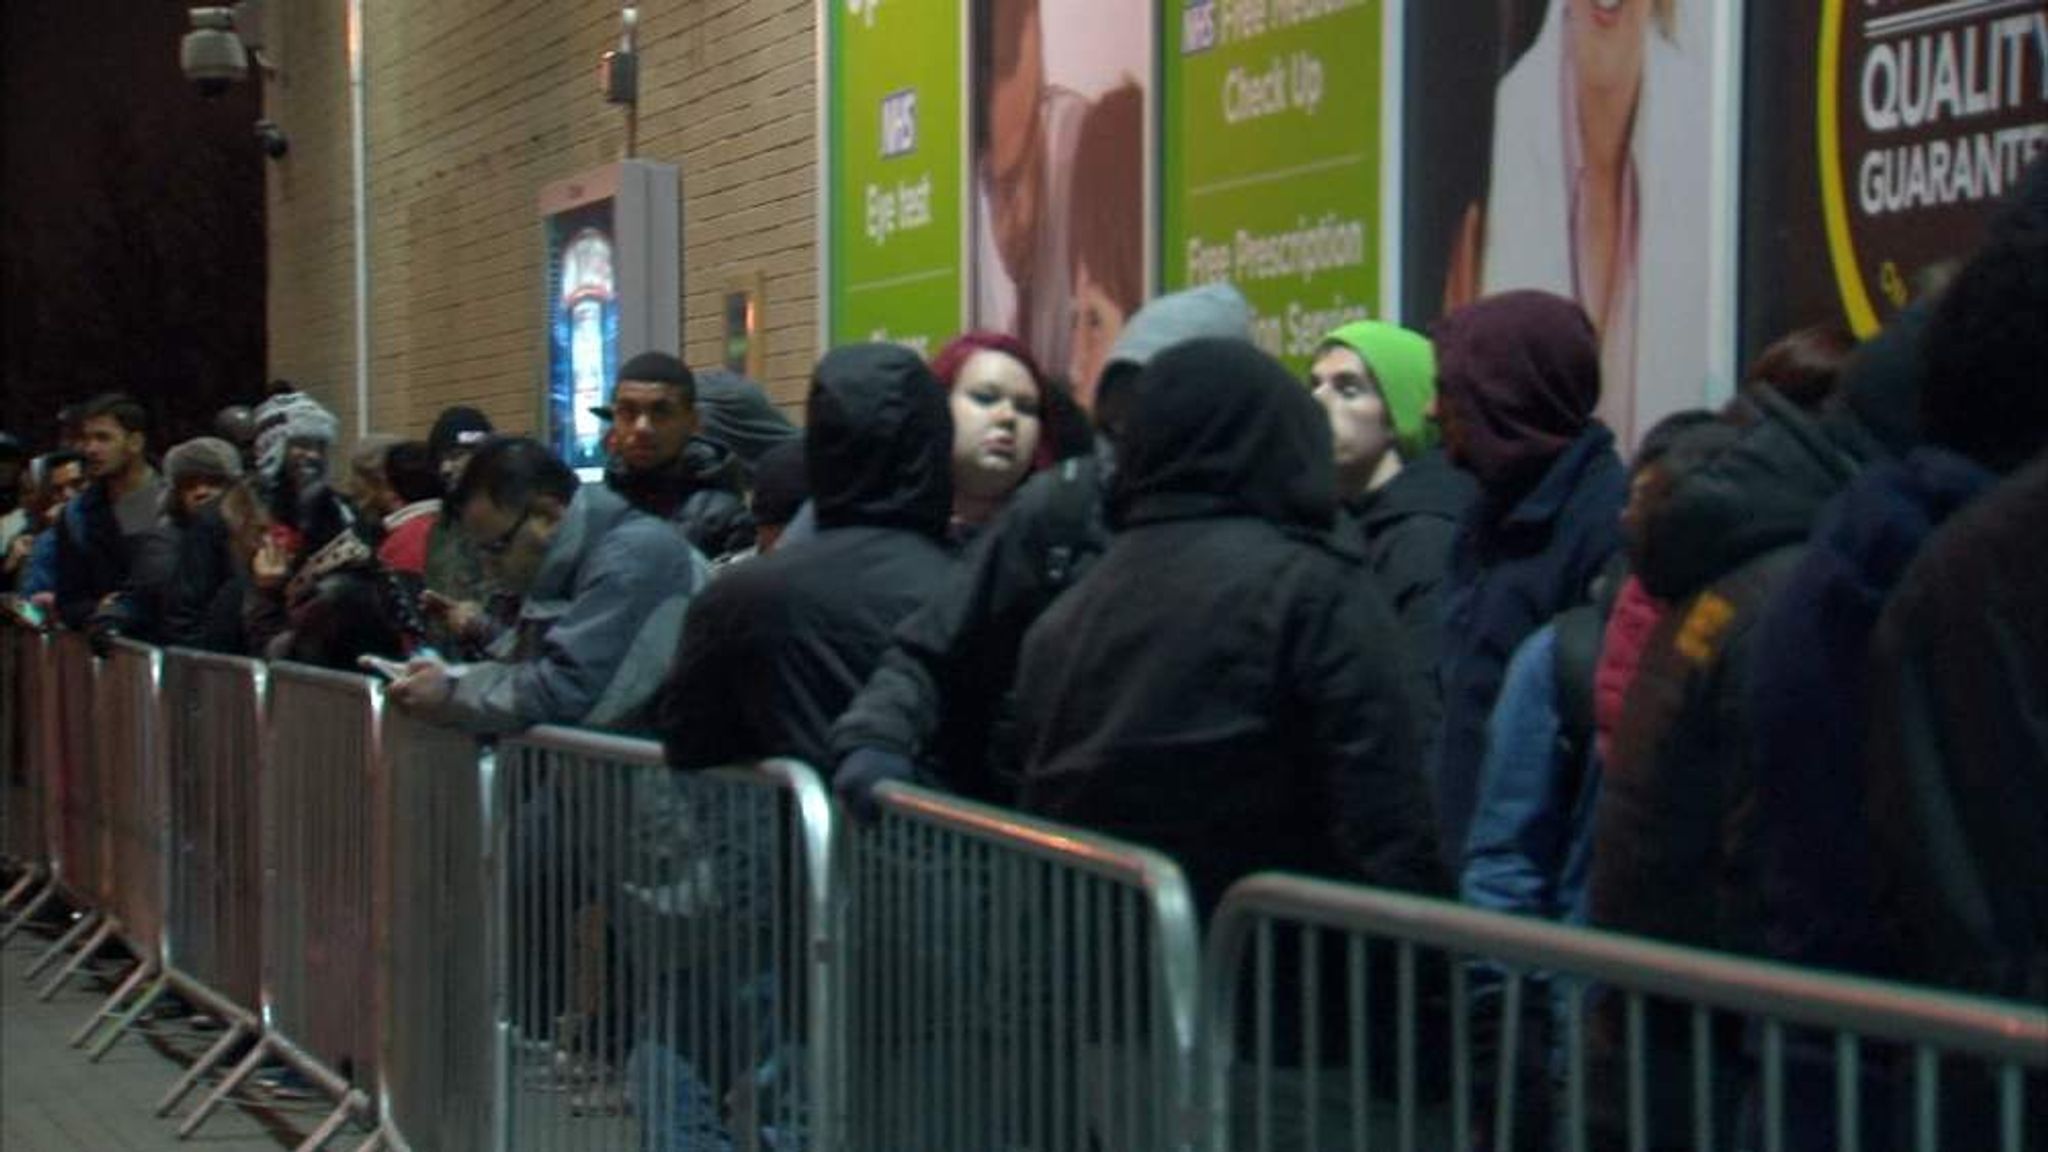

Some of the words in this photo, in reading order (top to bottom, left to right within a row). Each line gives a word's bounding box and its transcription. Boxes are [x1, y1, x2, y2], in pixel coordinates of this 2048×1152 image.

[1222, 57, 1288, 124] Check
[1291, 50, 1325, 117] Up
[1861, 11, 2048, 132] QUALITY
[880, 89, 918, 160] NHS
[1859, 123, 2048, 214] GUARANT
[866, 183, 896, 246] Eye
[898, 172, 933, 230] test
[1187, 235, 1230, 287] Free
[1234, 212, 1365, 284] Prescription
